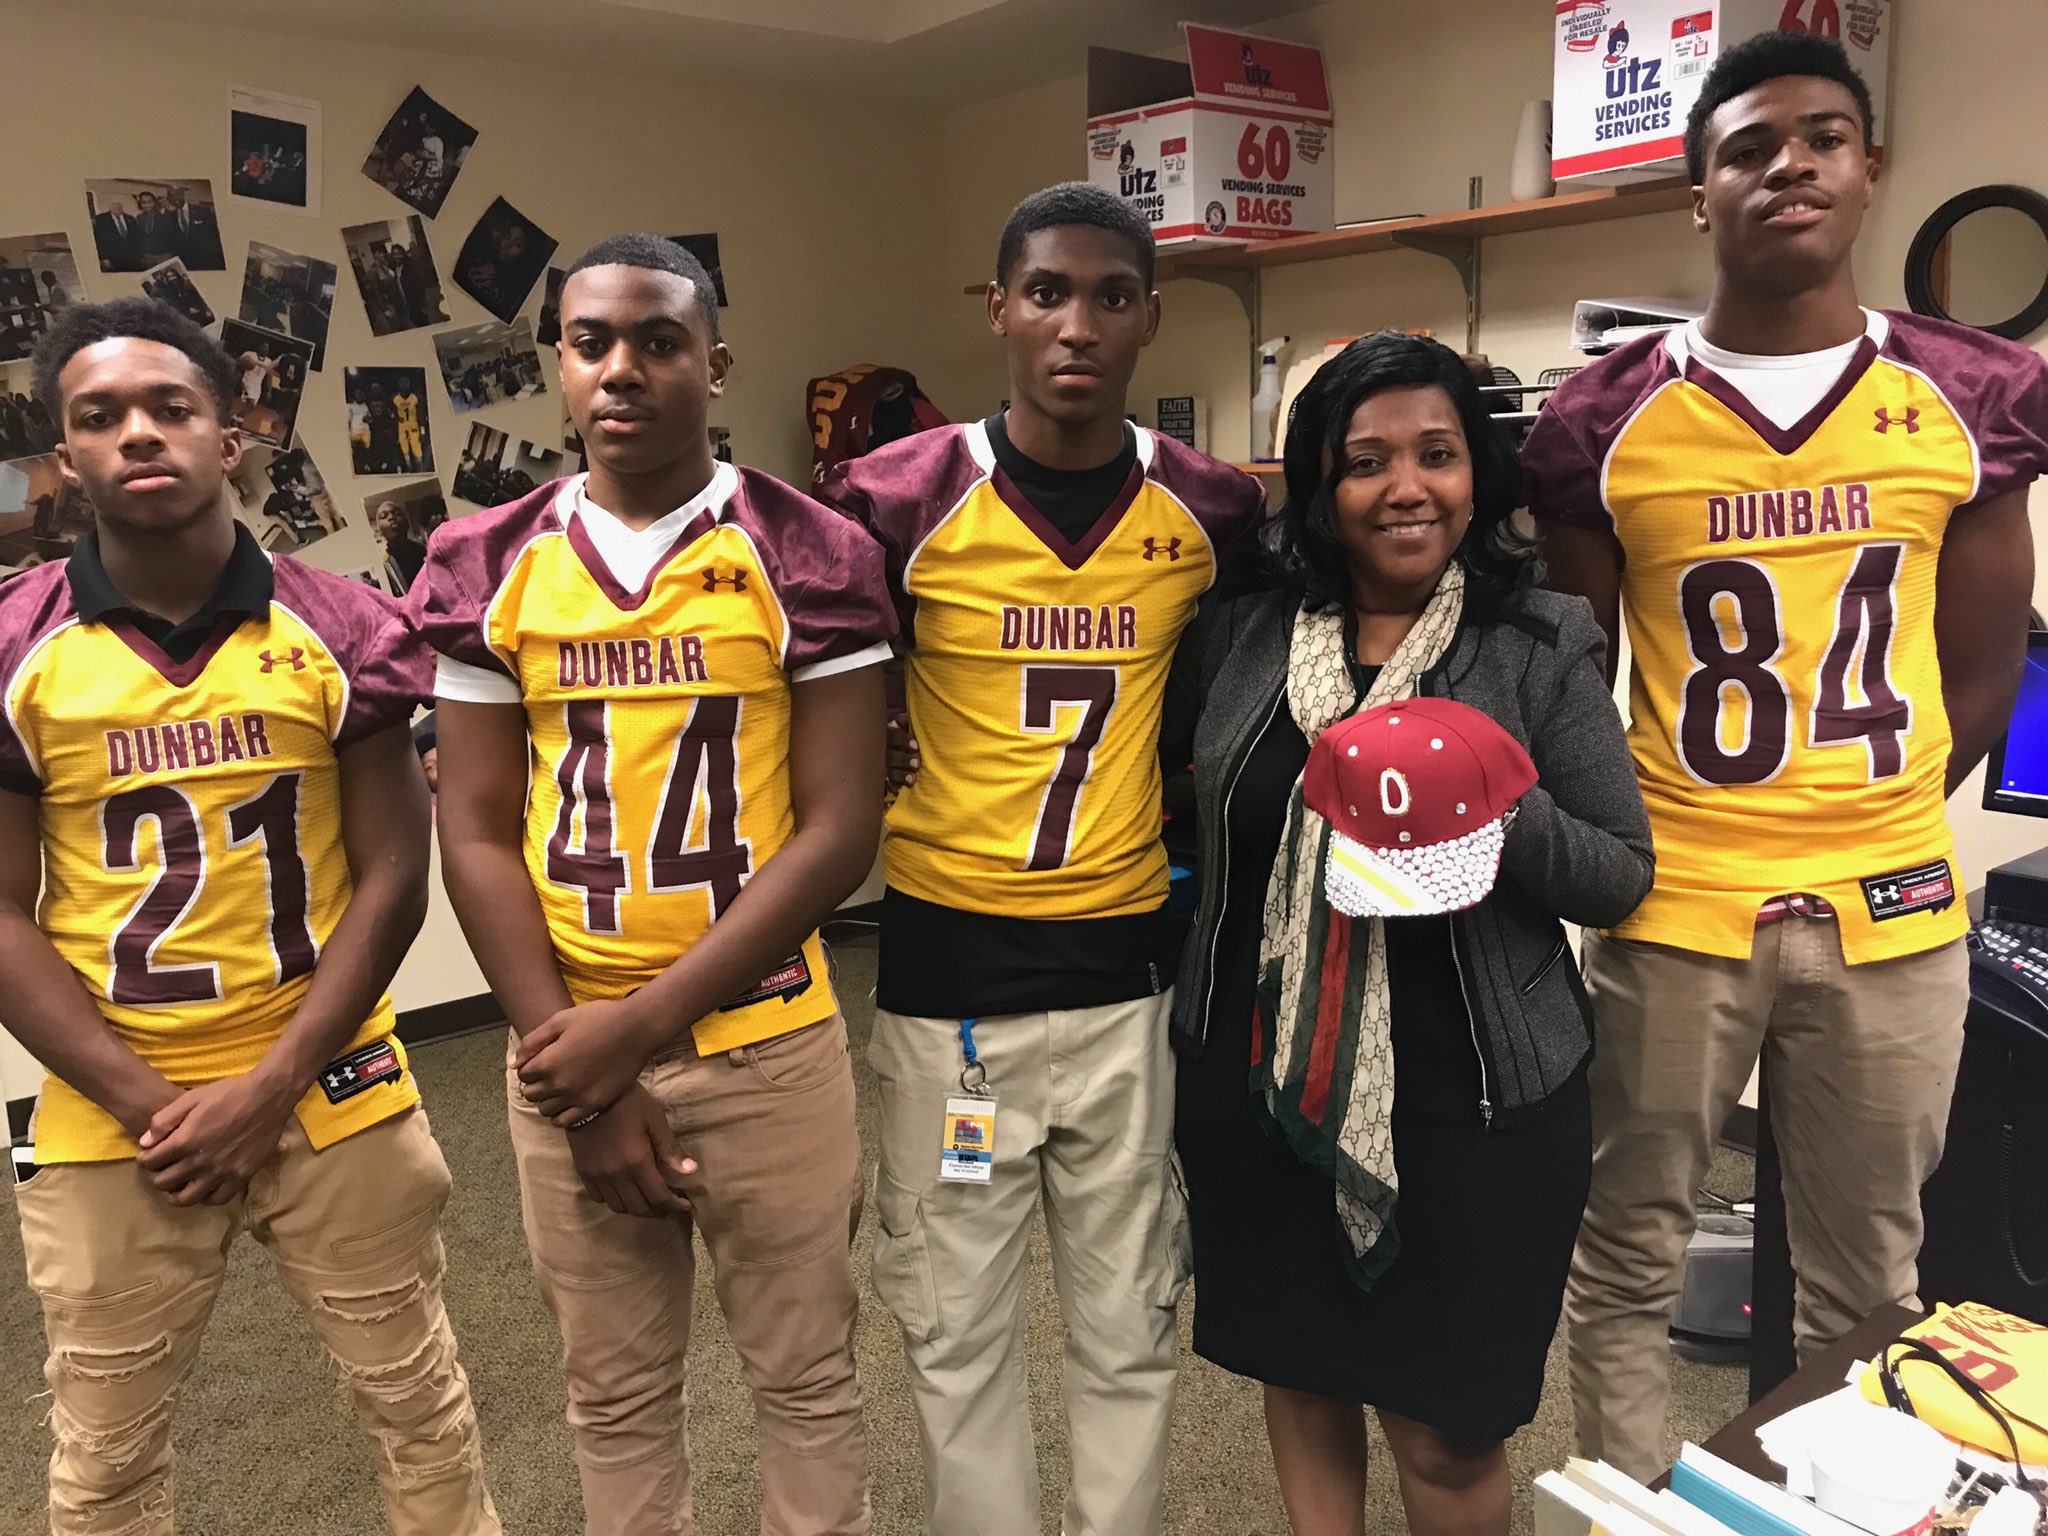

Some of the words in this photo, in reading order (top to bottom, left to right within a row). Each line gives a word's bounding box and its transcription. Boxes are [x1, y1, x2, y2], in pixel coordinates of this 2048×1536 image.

[1561, 7, 1611, 27] INDIVIDUALLY
[1569, 17, 1603, 32] LABELED
[1563, 30, 1578, 42] FOR
[1580, 25, 1608, 38] RESALE
[1223, 82, 1261, 97] VENDING
[1262, 88, 1298, 102] SERVICES
[1595, 91, 1672, 122] VENDING
[1595, 110, 1671, 141] SERVICES
[1237, 121, 1291, 182] 60
[1222, 178, 1264, 194] VENDING
[1266, 183, 1306, 198] SERVICES
[1236, 196, 1293, 226] BAGS
[1162, 399, 1190, 412] FAITH
[1707, 482, 1873, 543] DUNBAR
[1000, 604, 1137, 651] DUNBAR
[557, 634, 710, 688] DUNBAR
[1676, 541, 1914, 787] 84
[105, 713, 272, 777] DUNBAR
[1019, 664, 1120, 871] 7
[545, 695, 755, 936] 44
[101, 768, 321, 1006] 21
[1911, 882, 1945, 899] AUTHENTIC
[761, 968, 798, 988] AUTHENTIC
